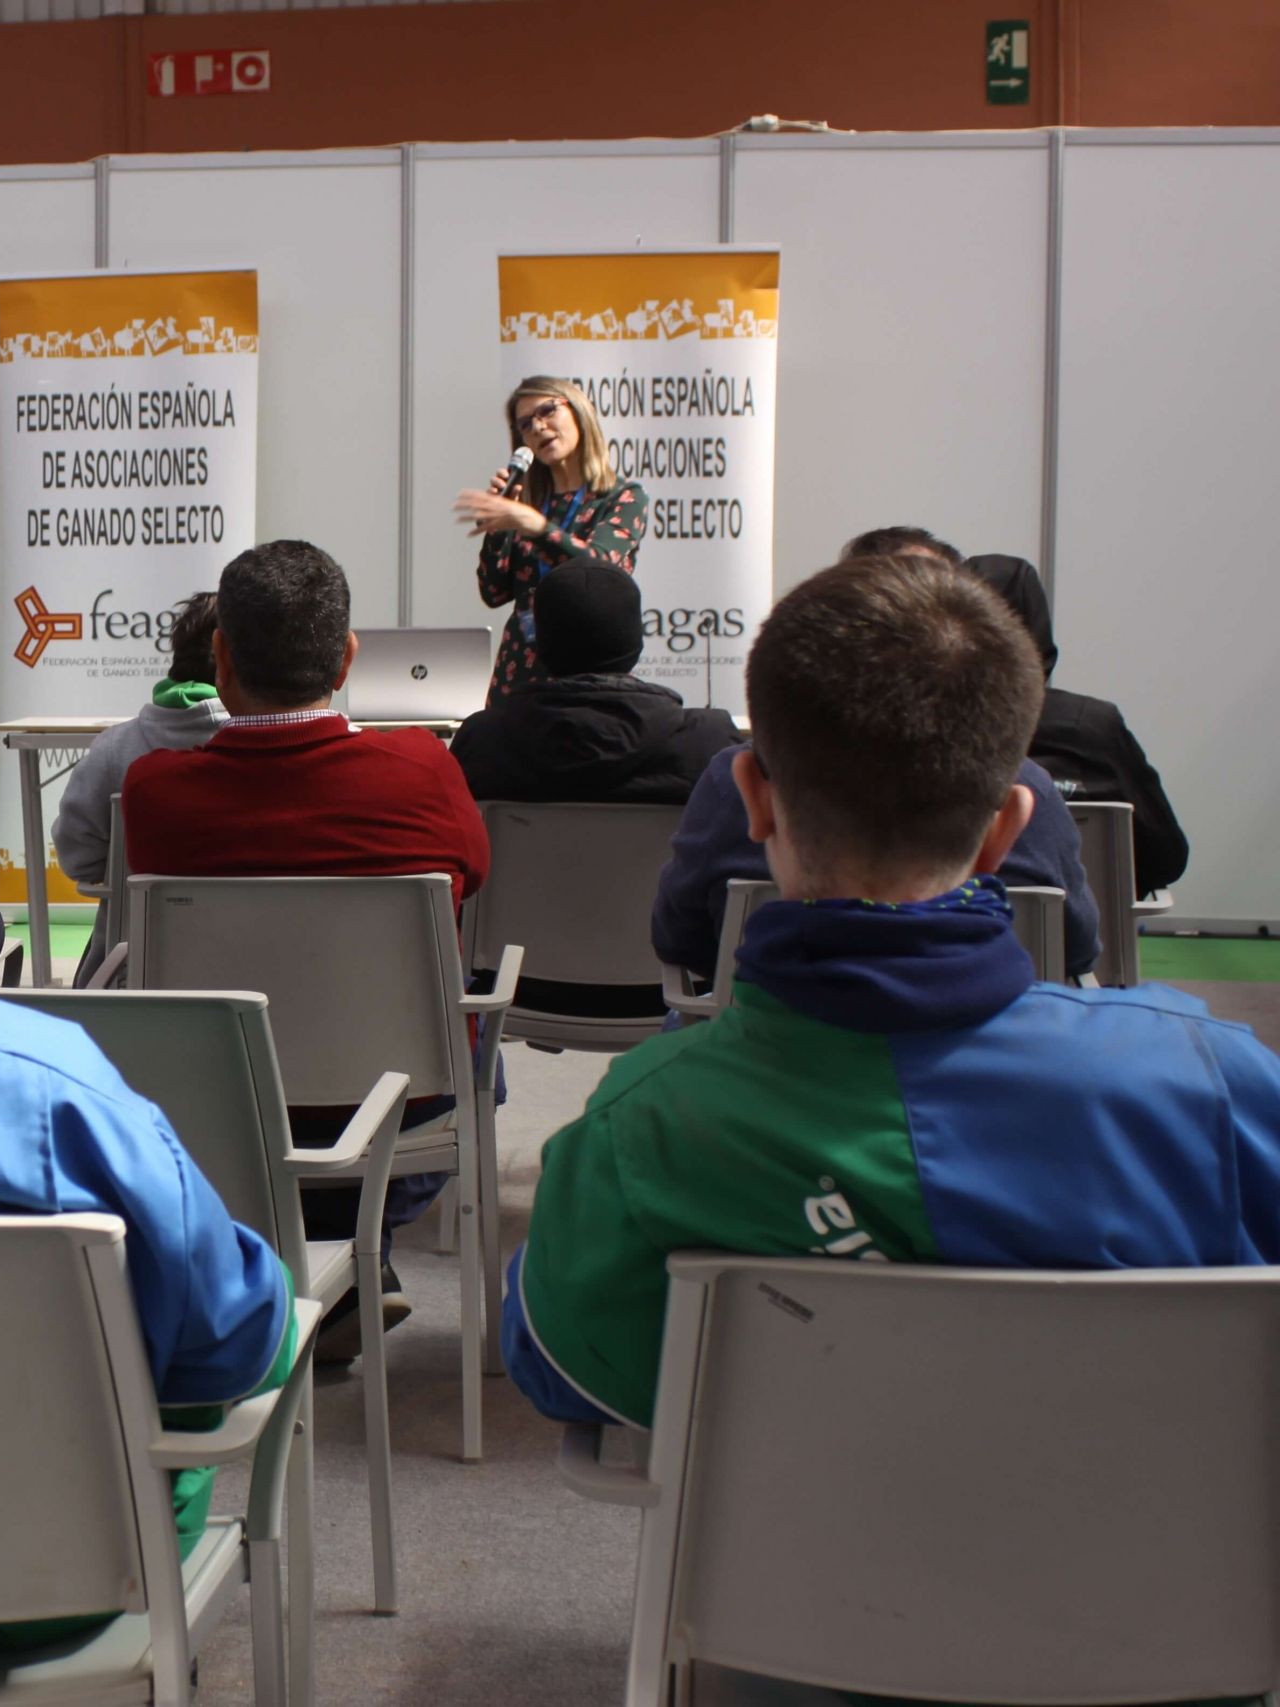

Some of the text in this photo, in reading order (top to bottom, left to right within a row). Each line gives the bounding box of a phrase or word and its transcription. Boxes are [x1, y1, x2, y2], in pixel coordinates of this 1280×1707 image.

[16, 381, 235, 432] FEDERACIÓN ESPAÑOLA
[651, 368, 755, 417] ESPAÑOLA
[42, 446, 209, 488] DE ASOCIACIONES
[607, 437, 727, 478] OCIACIONES
[27, 504, 224, 547] DE GANADO SELECTO
[653, 498, 743, 539] SELECTO
[89, 588, 178, 653] feag
[641, 607, 745, 653] agas
